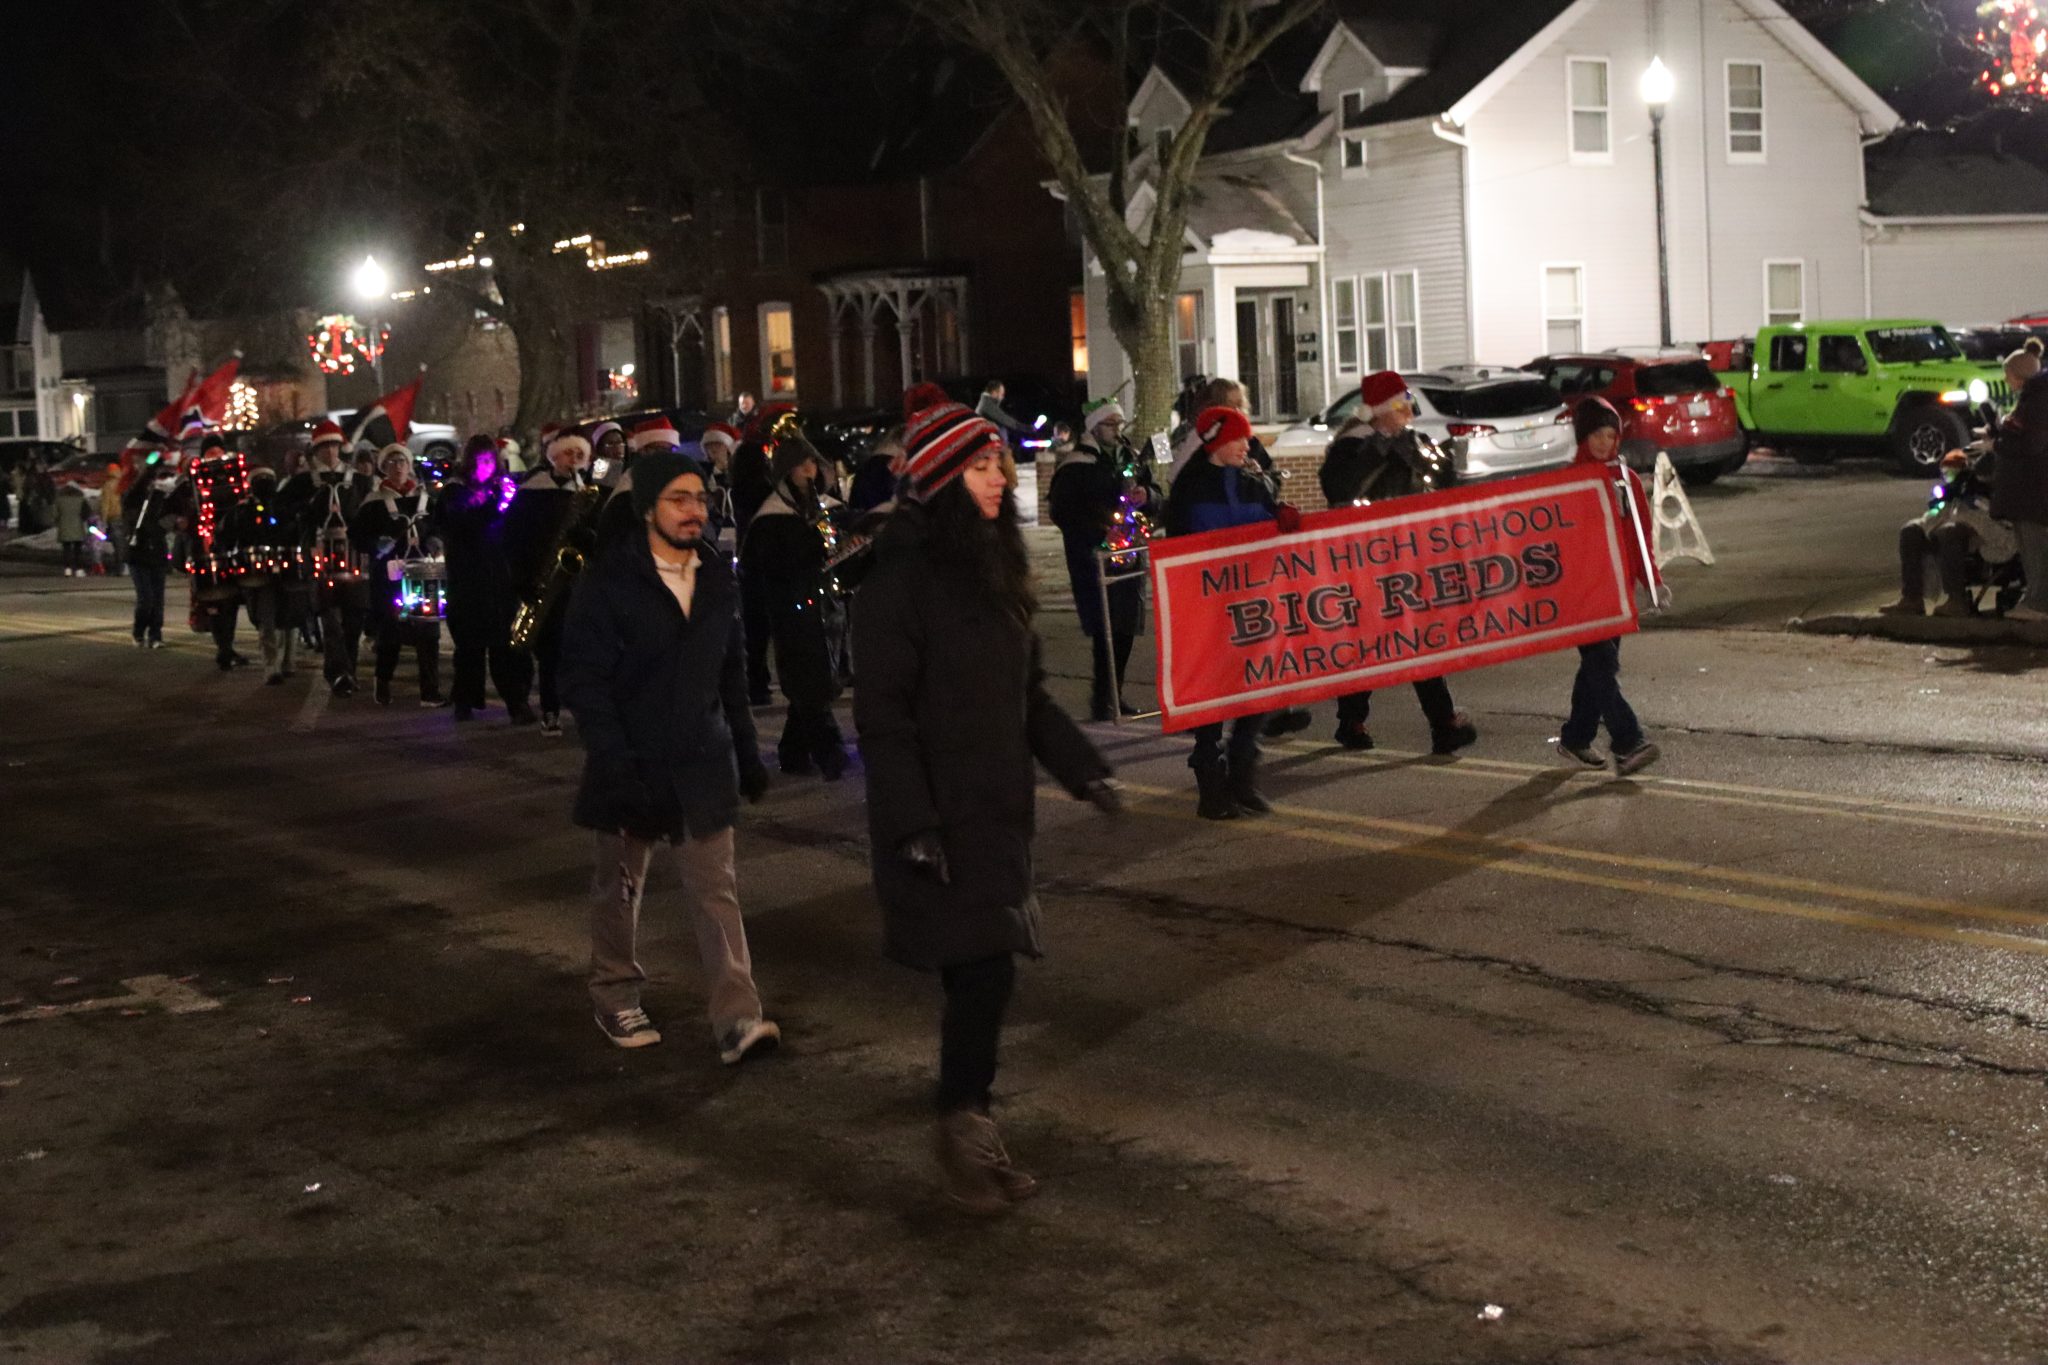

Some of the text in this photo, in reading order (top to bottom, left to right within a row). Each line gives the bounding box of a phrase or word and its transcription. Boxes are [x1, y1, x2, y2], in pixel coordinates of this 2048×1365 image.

[1201, 503, 1575, 597] MILAN HIGH SCHOOL
[1226, 541, 1563, 645] BIG REDS
[1244, 598, 1559, 685] MARCHING BAND
